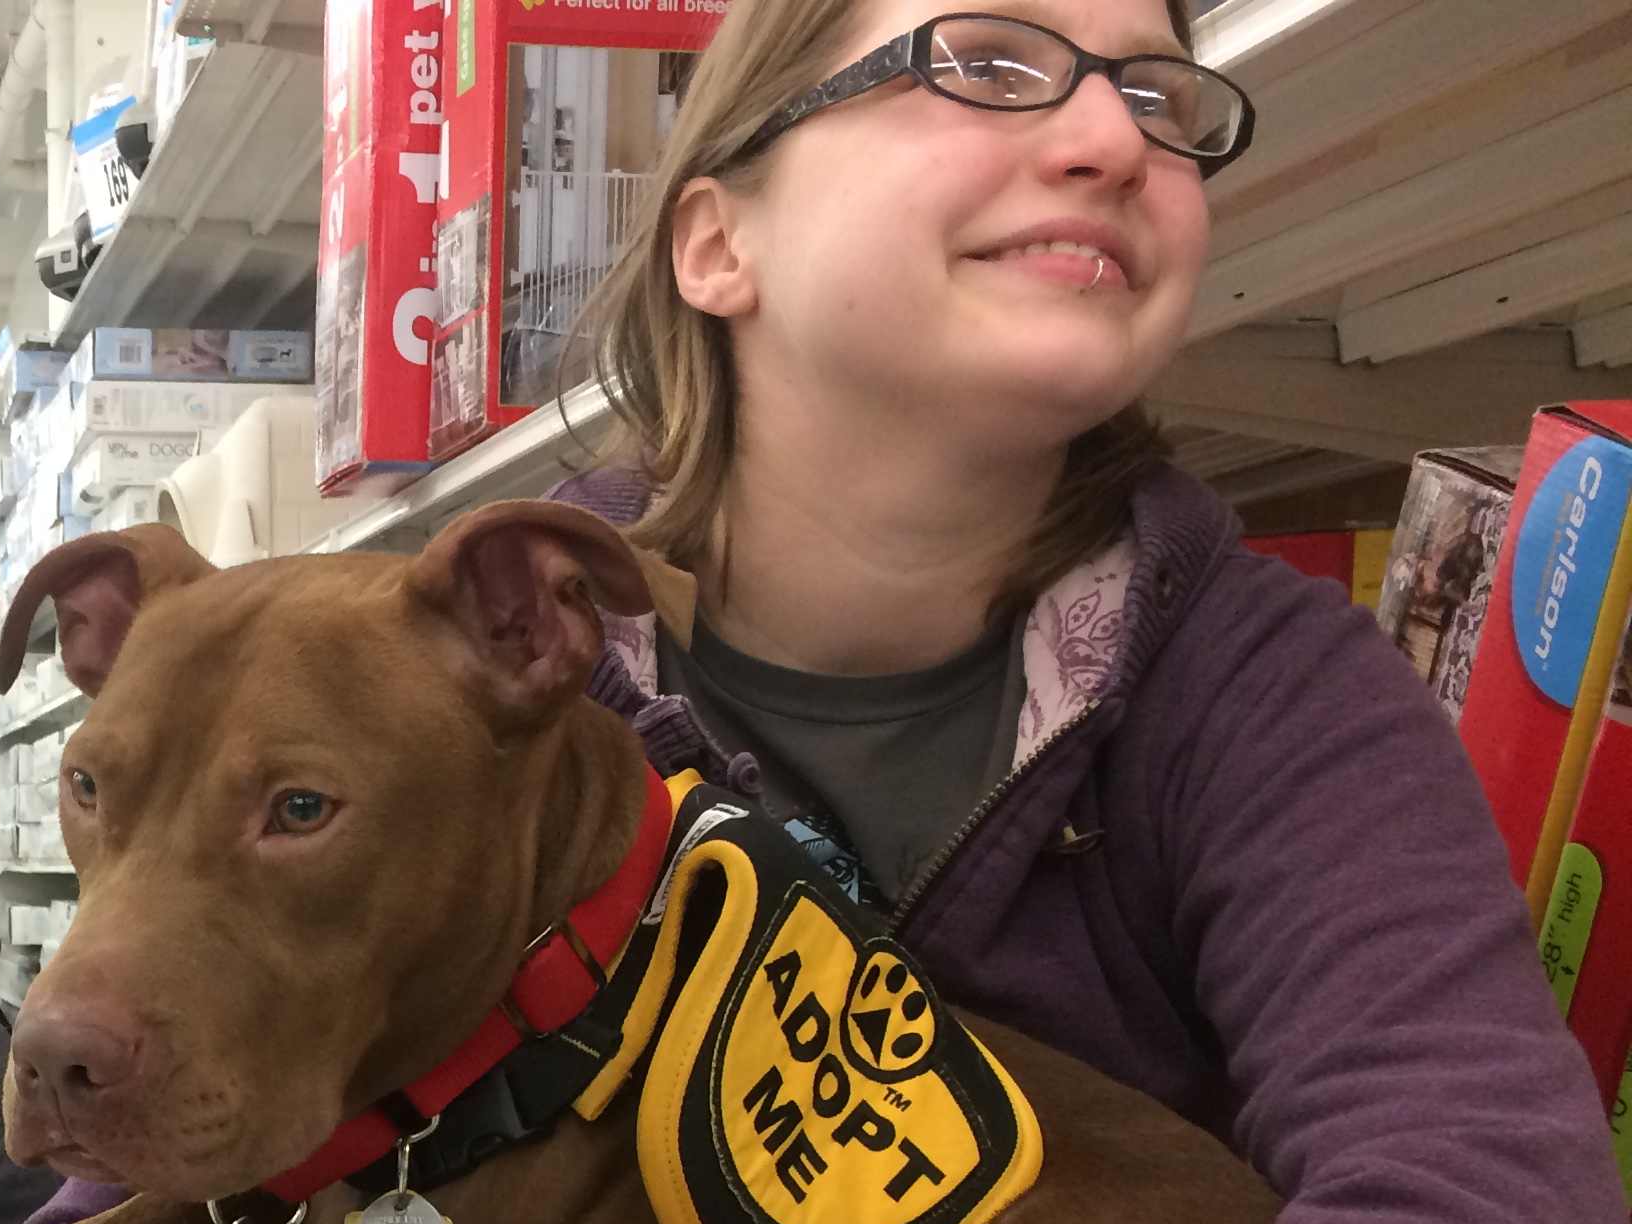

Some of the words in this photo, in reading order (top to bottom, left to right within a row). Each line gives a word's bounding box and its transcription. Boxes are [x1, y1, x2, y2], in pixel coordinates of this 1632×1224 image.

[404, 30, 445, 125] pet
[103, 155, 130, 208] 169
[1535, 456, 1602, 660] Carlson
[1557, 871, 1583, 924] high
[742, 1064, 829, 1205] ME
[764, 949, 947, 1203] ADOPT
